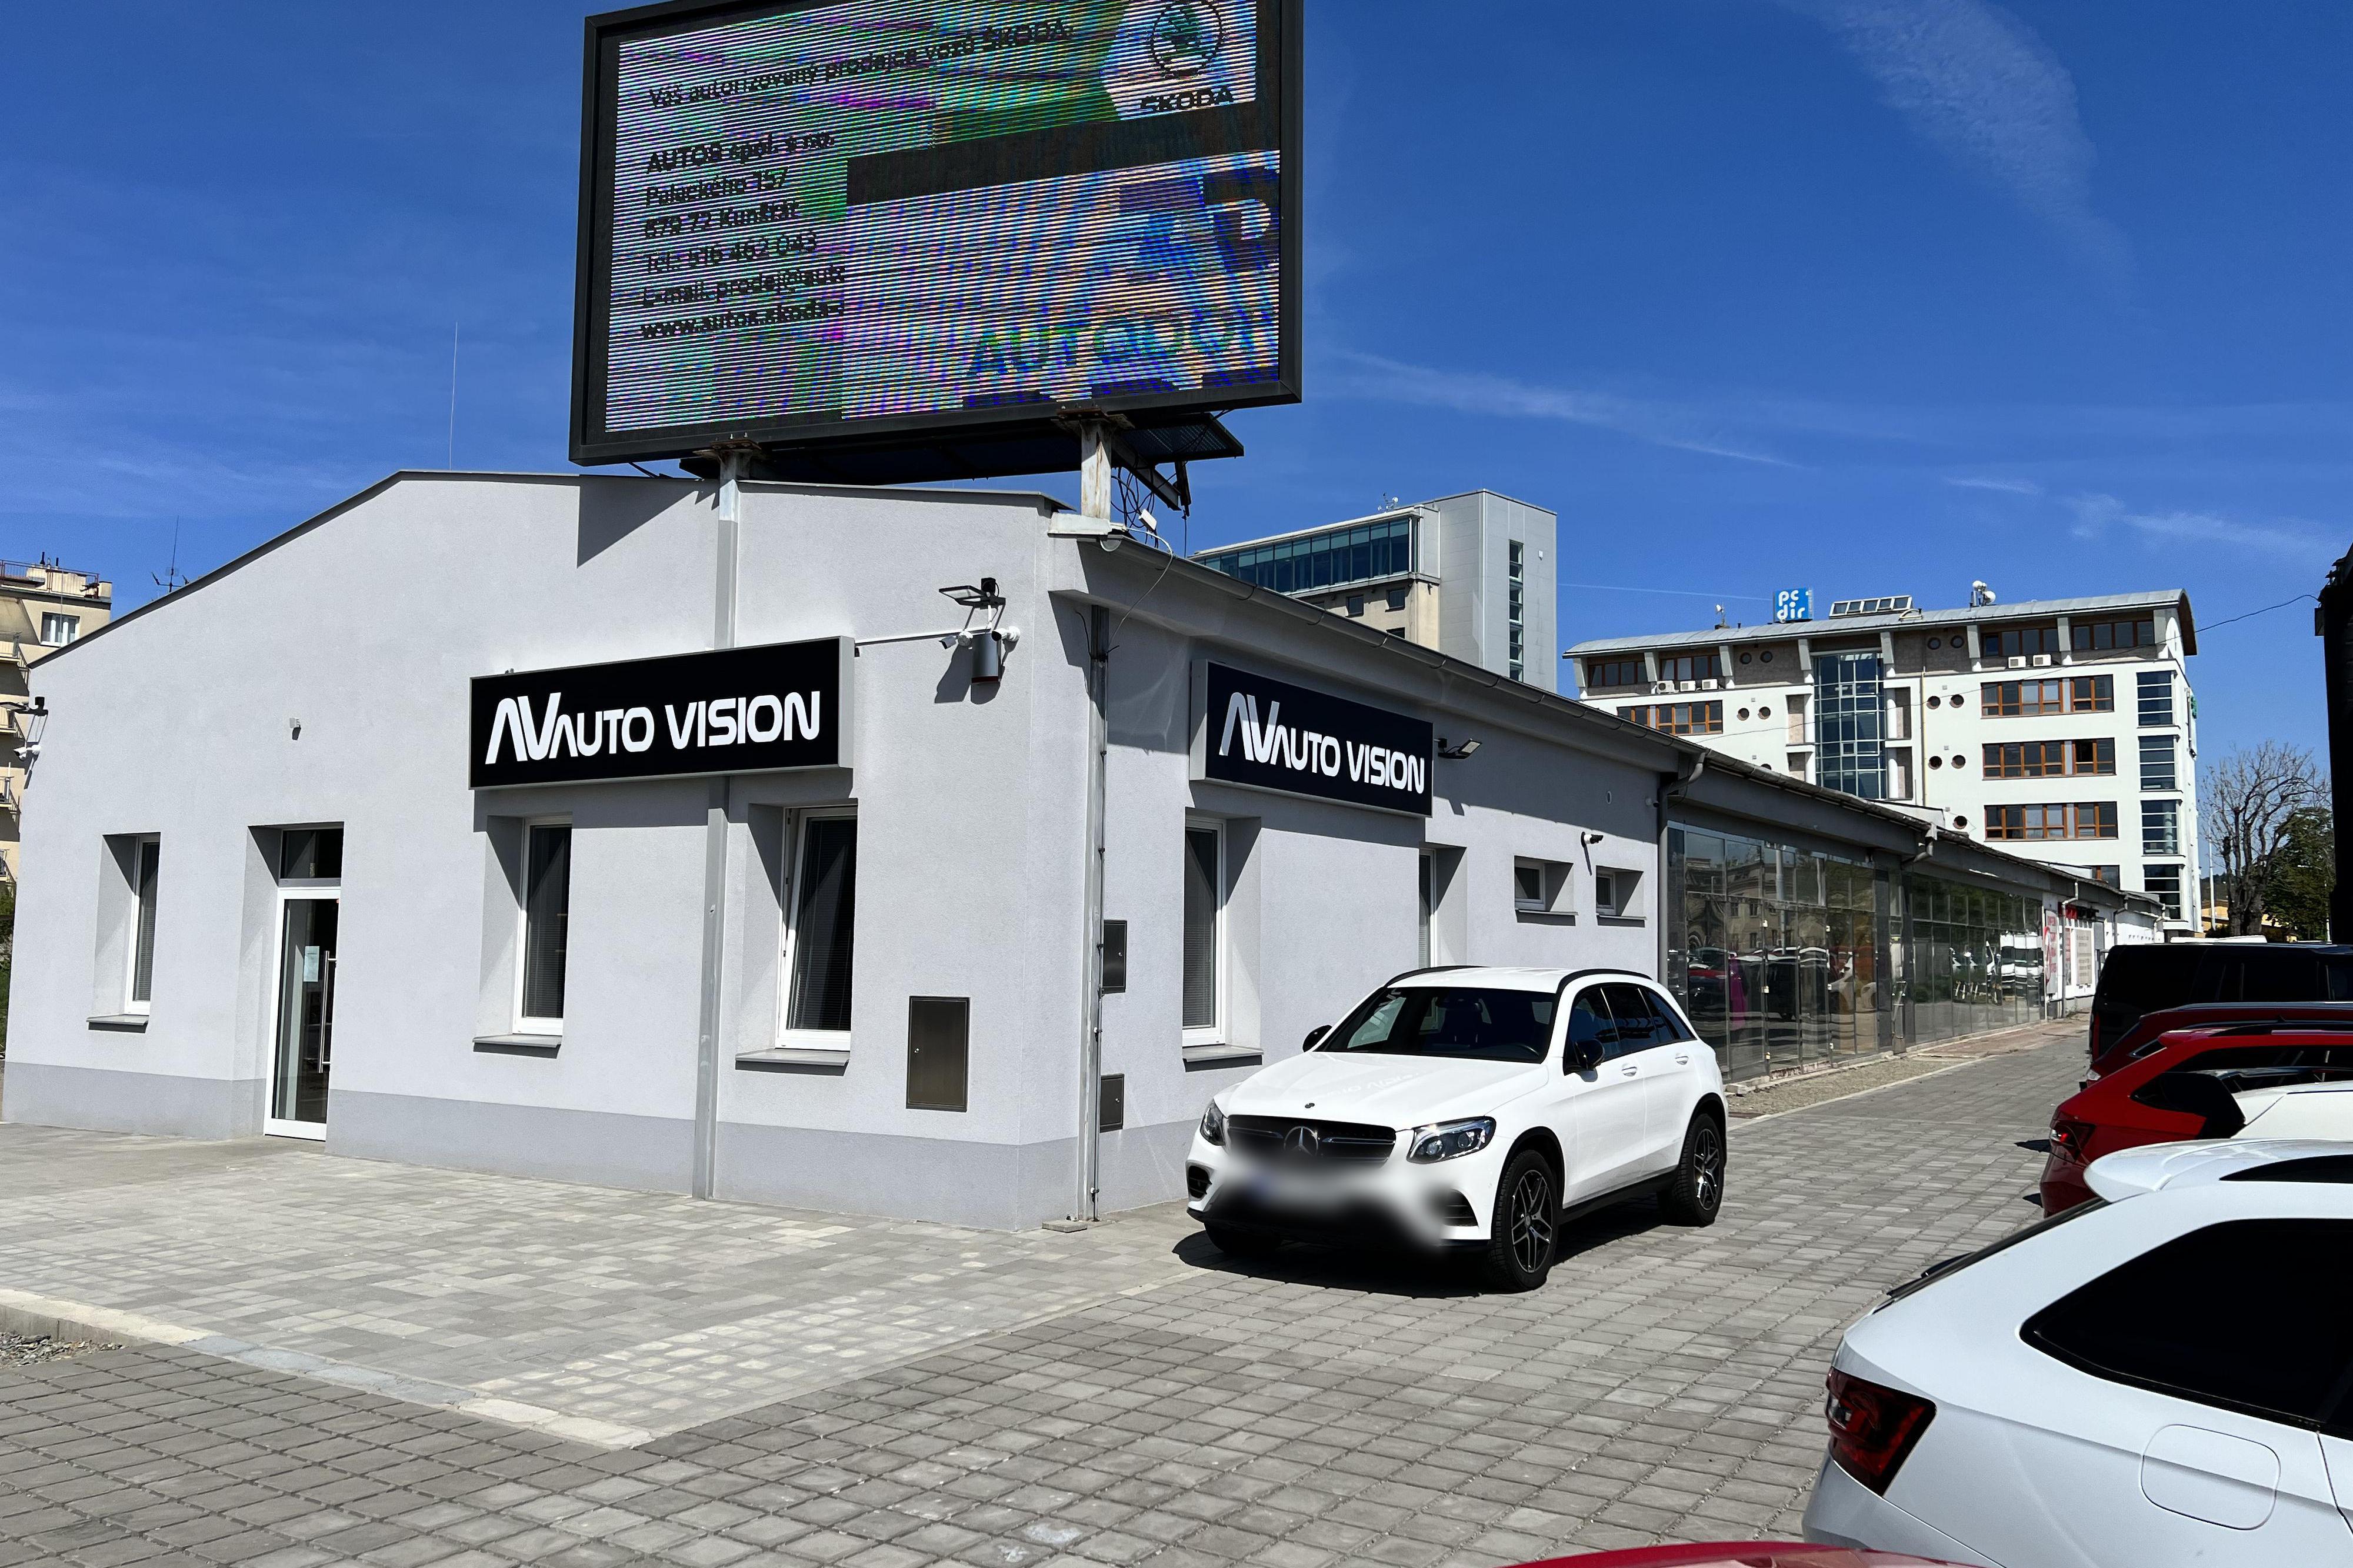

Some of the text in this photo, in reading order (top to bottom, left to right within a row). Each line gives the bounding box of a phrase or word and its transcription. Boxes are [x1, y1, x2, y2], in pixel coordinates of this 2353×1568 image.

[1777, 602, 1805, 620] dir
[1778, 590, 1798, 606] pc
[665, 690, 820, 749] VISION
[1347, 740, 1424, 794] VISION
